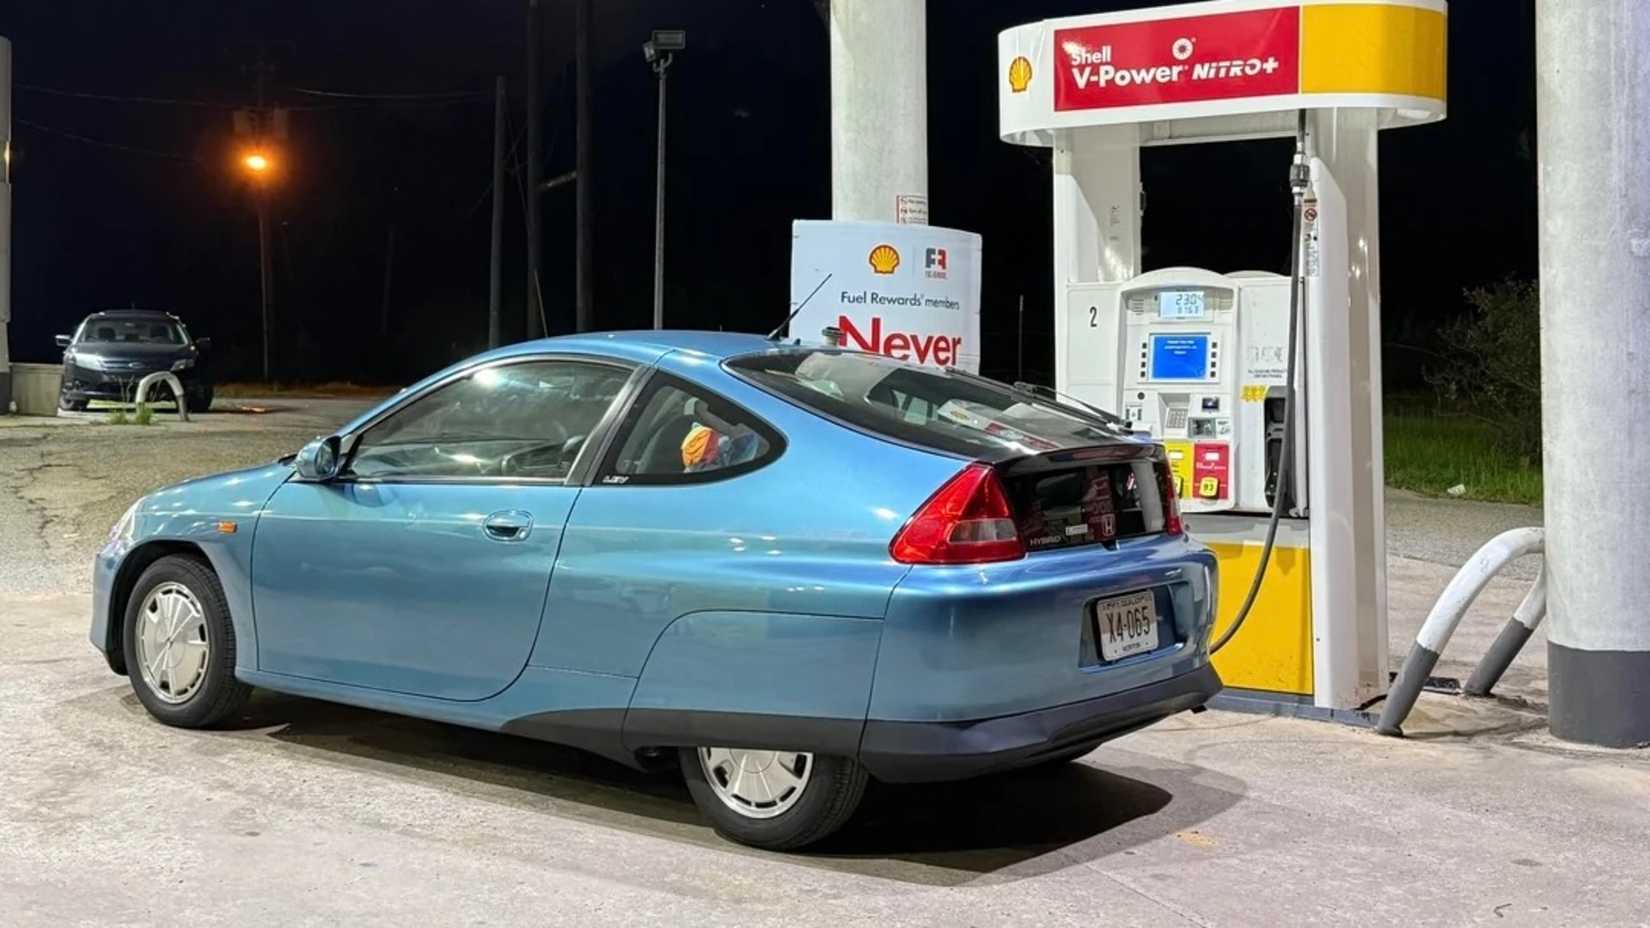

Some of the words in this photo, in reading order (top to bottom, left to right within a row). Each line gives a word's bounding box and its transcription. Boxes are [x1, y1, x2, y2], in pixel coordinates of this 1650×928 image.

[1071, 45, 1112, 65] Shell
[1072, 63, 1184, 90] V-Power
[840, 290, 867, 305] Fuel
[924, 297, 960, 311] members
[1089, 306, 1098, 328] 2
[838, 315, 962, 366] Never
[1030, 535, 1062, 546] HYBRID
